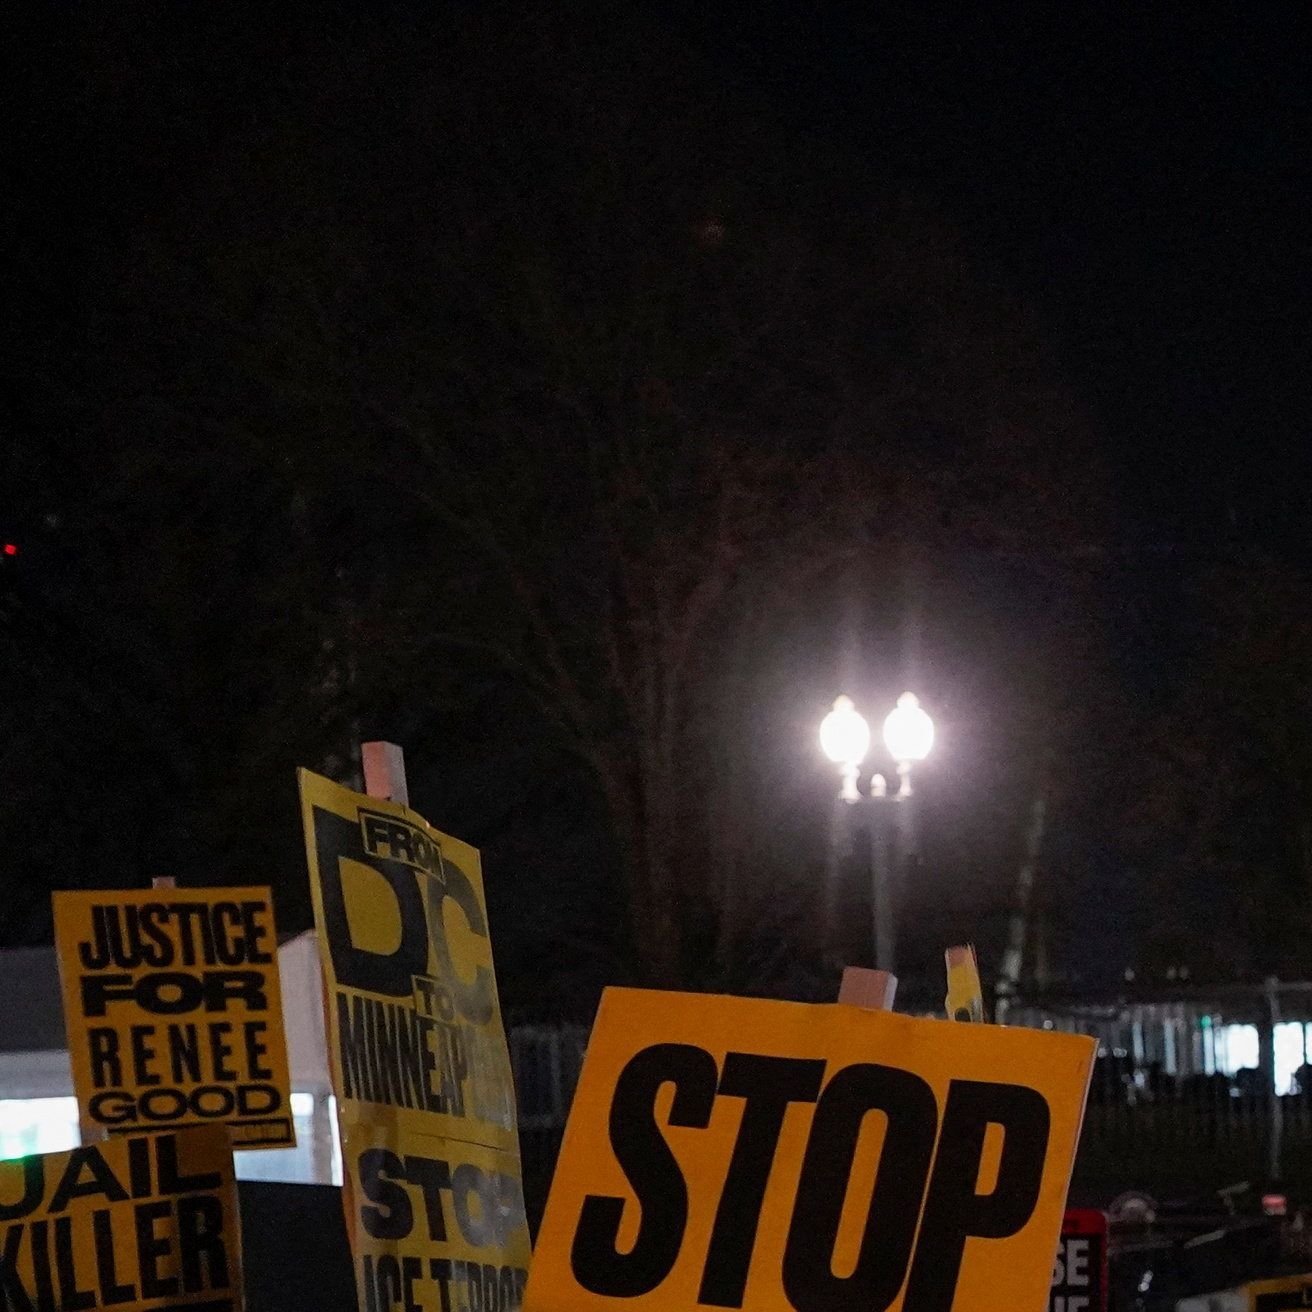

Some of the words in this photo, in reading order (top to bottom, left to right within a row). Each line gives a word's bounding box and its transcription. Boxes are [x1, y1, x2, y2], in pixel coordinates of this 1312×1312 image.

[79, 901, 272, 970] JUSTICE
[312, 803, 493, 1025] DC
[80, 971, 267, 1017] FOR
[88, 1021, 272, 1087] RENEE
[336, 992, 512, 1128] MINNEAP
[89, 1084, 281, 1124] GOOD
[0, 1134, 222, 1220] JAIL
[358, 1148, 521, 1248] STOP
